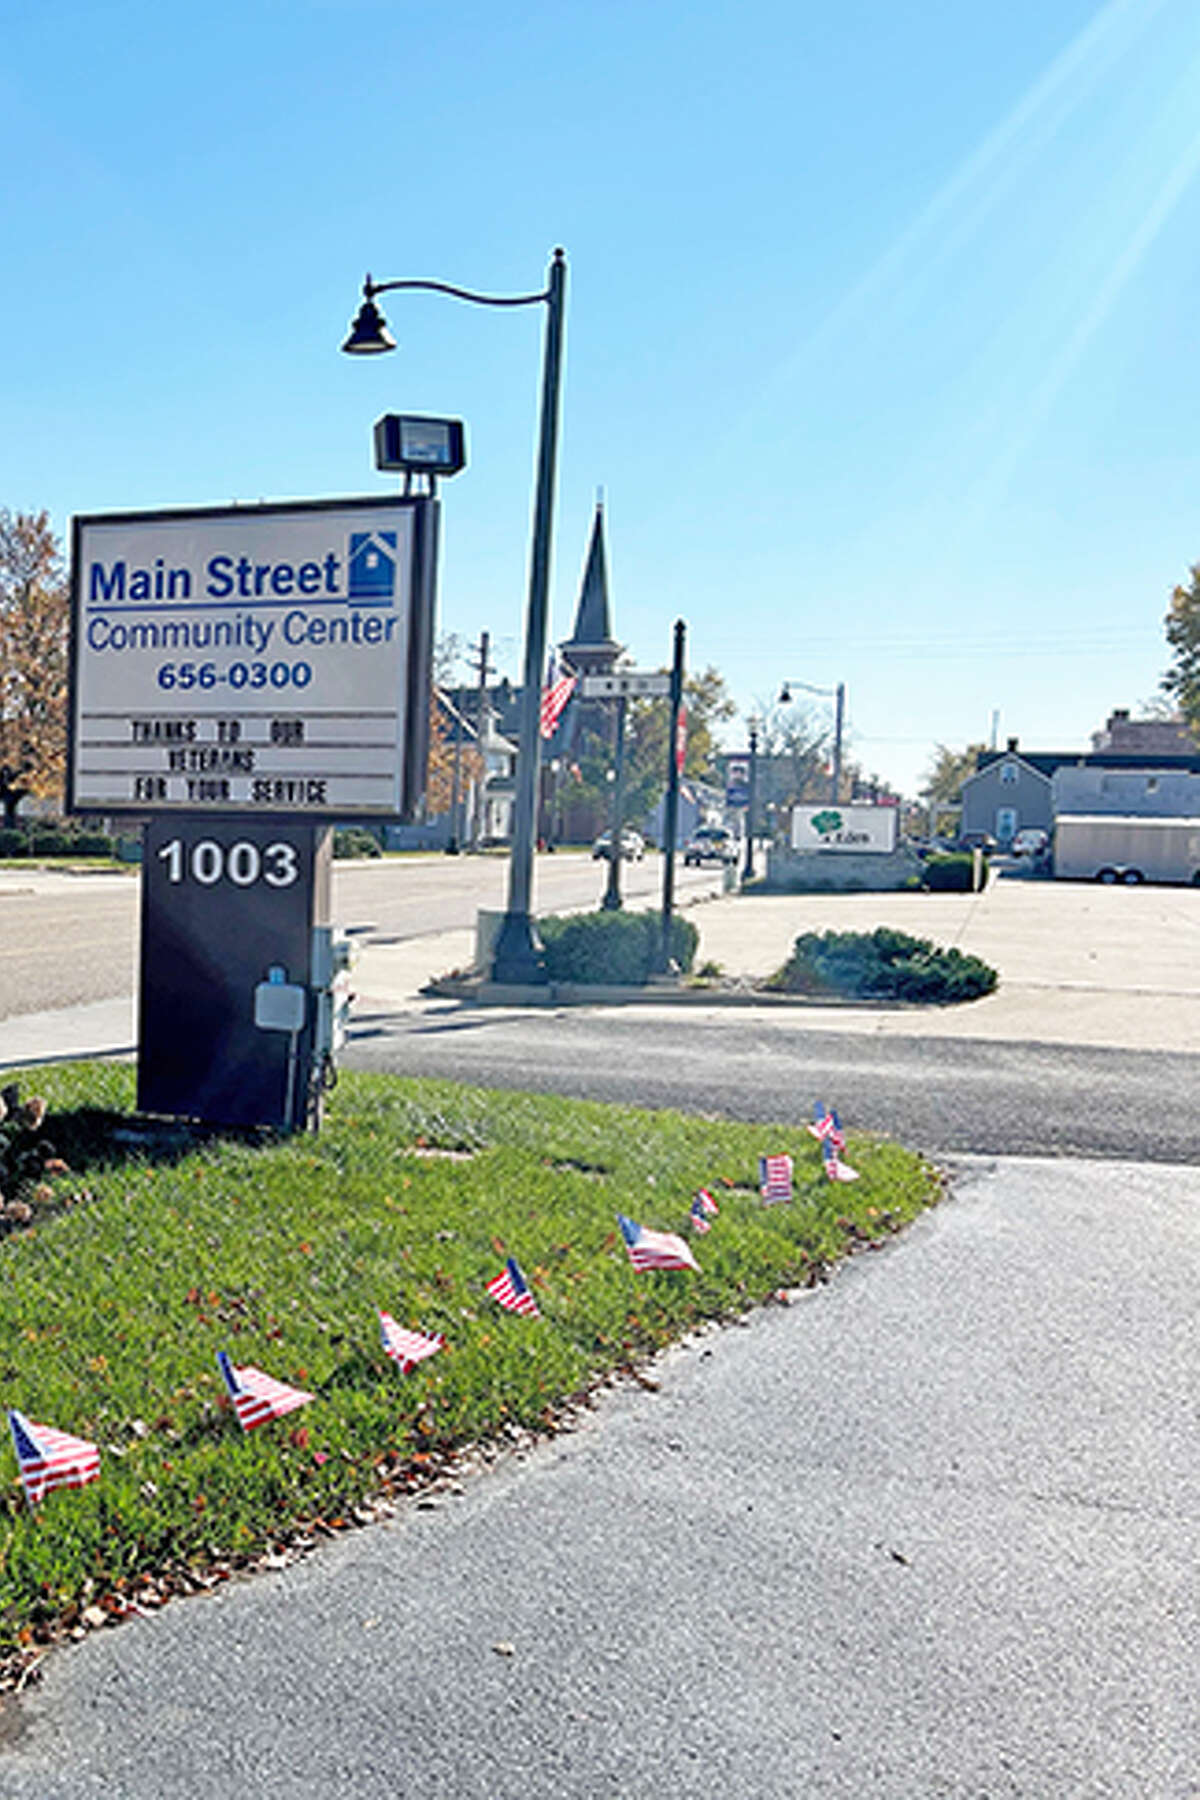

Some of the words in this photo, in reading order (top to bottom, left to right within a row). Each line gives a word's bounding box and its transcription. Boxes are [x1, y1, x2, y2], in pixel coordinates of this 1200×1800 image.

[90, 558, 191, 601] Main
[206, 553, 340, 598] Street
[87, 612, 275, 654] Community
[283, 610, 398, 645] Center
[158, 661, 312, 689] 656-0300
[131, 720, 197, 742] THANKS
[217, 720, 241, 743] TO
[270, 720, 304, 744] OUR
[168, 749, 255, 771] VETERANS
[134, 777, 167, 800] FOR
[187, 778, 230, 801] YOUR
[251, 780, 327, 803] SERVICE
[158, 839, 298, 886] 1003
